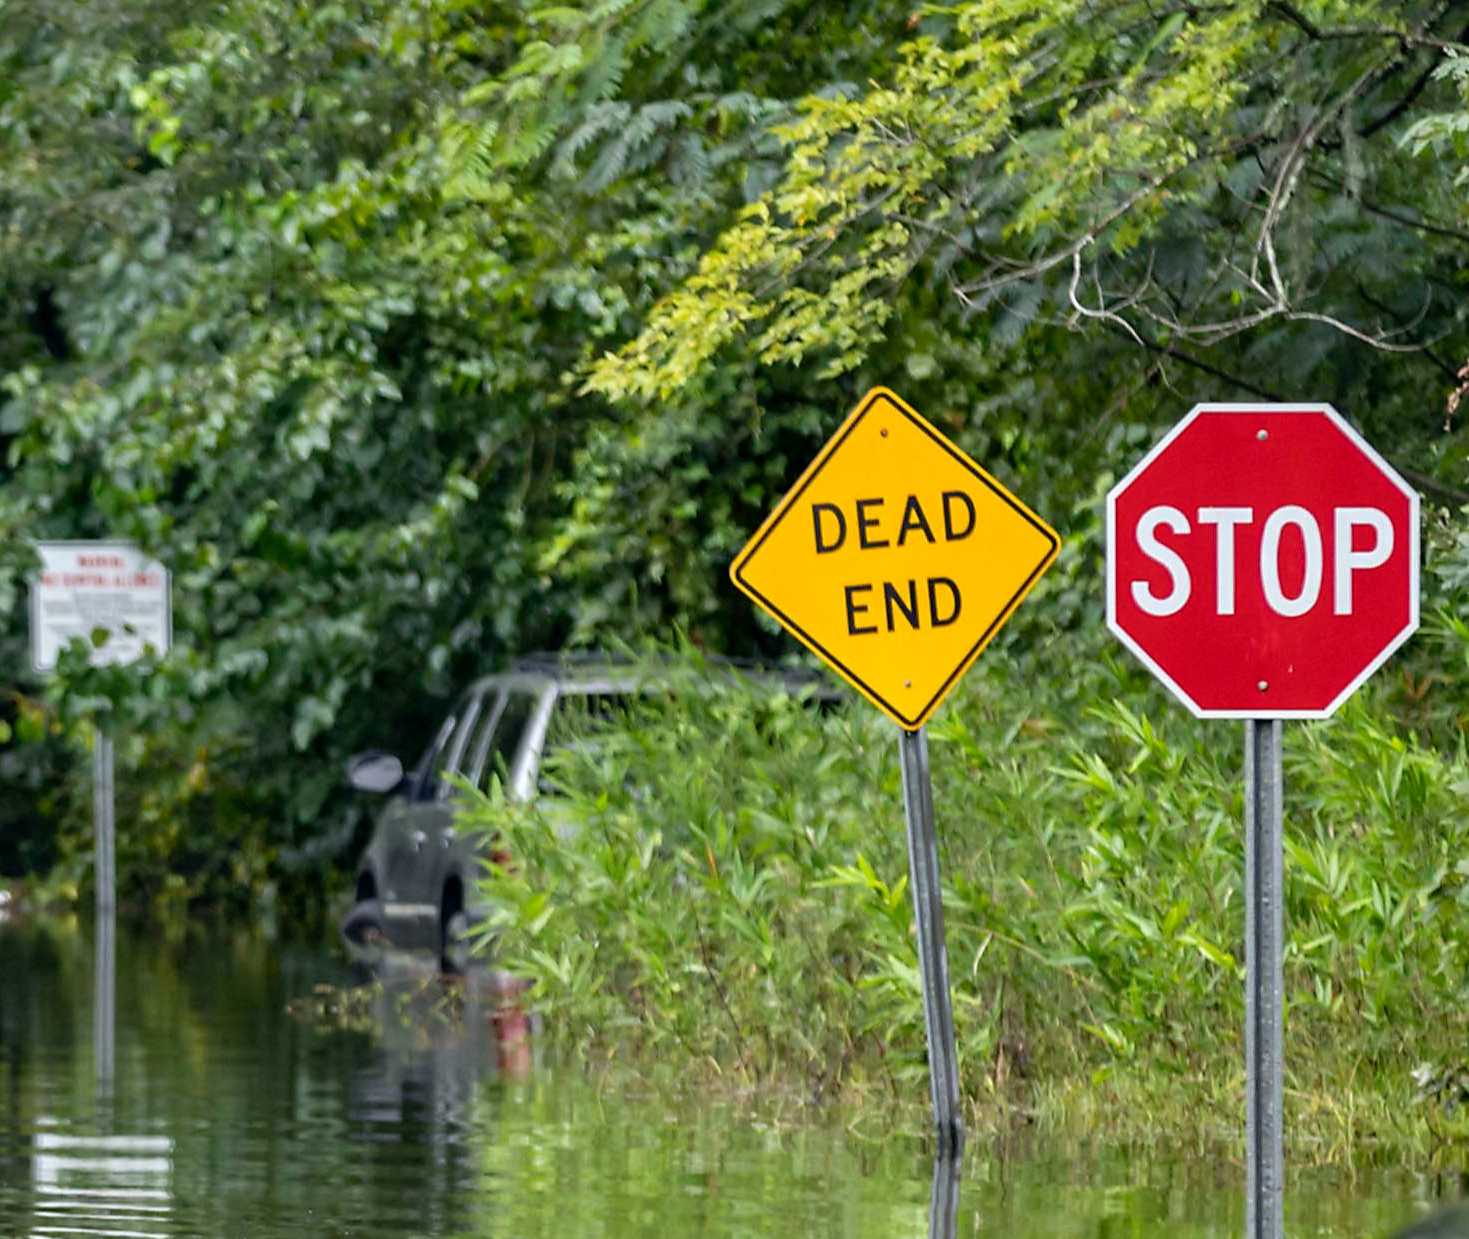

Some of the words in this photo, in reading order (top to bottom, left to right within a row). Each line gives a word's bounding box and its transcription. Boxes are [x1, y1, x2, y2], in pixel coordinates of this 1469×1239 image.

[811, 491, 977, 555] DEAD
[1130, 504, 1395, 617] STOP
[844, 577, 962, 637] END
